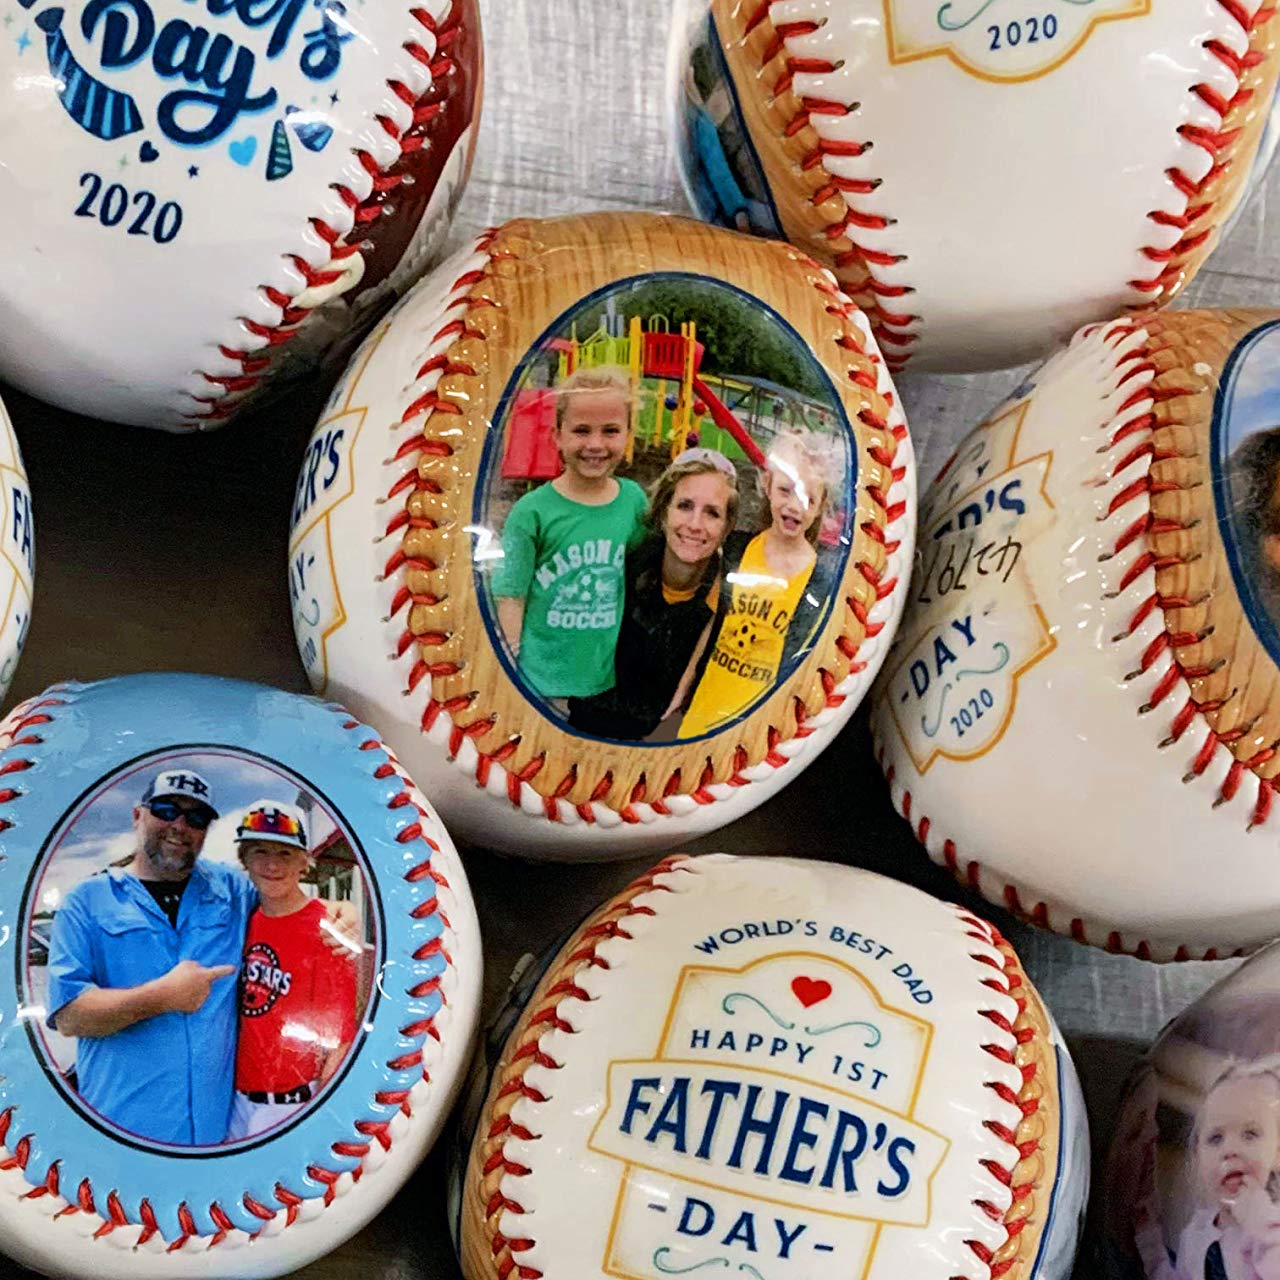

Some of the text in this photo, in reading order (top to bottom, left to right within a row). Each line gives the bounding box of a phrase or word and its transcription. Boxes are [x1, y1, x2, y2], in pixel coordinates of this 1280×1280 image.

[987, 15, 1059, 51] 2020
[81, 0, 277, 146] Day
[73, 172, 184, 244] 2020
[950, 687, 994, 737] 2020
[694, 919, 934, 1006] WORLD'S BEST DAD
[690, 1029, 889, 1091] HAPPY 1ST
[619, 1076, 917, 1199] FATHER'S
